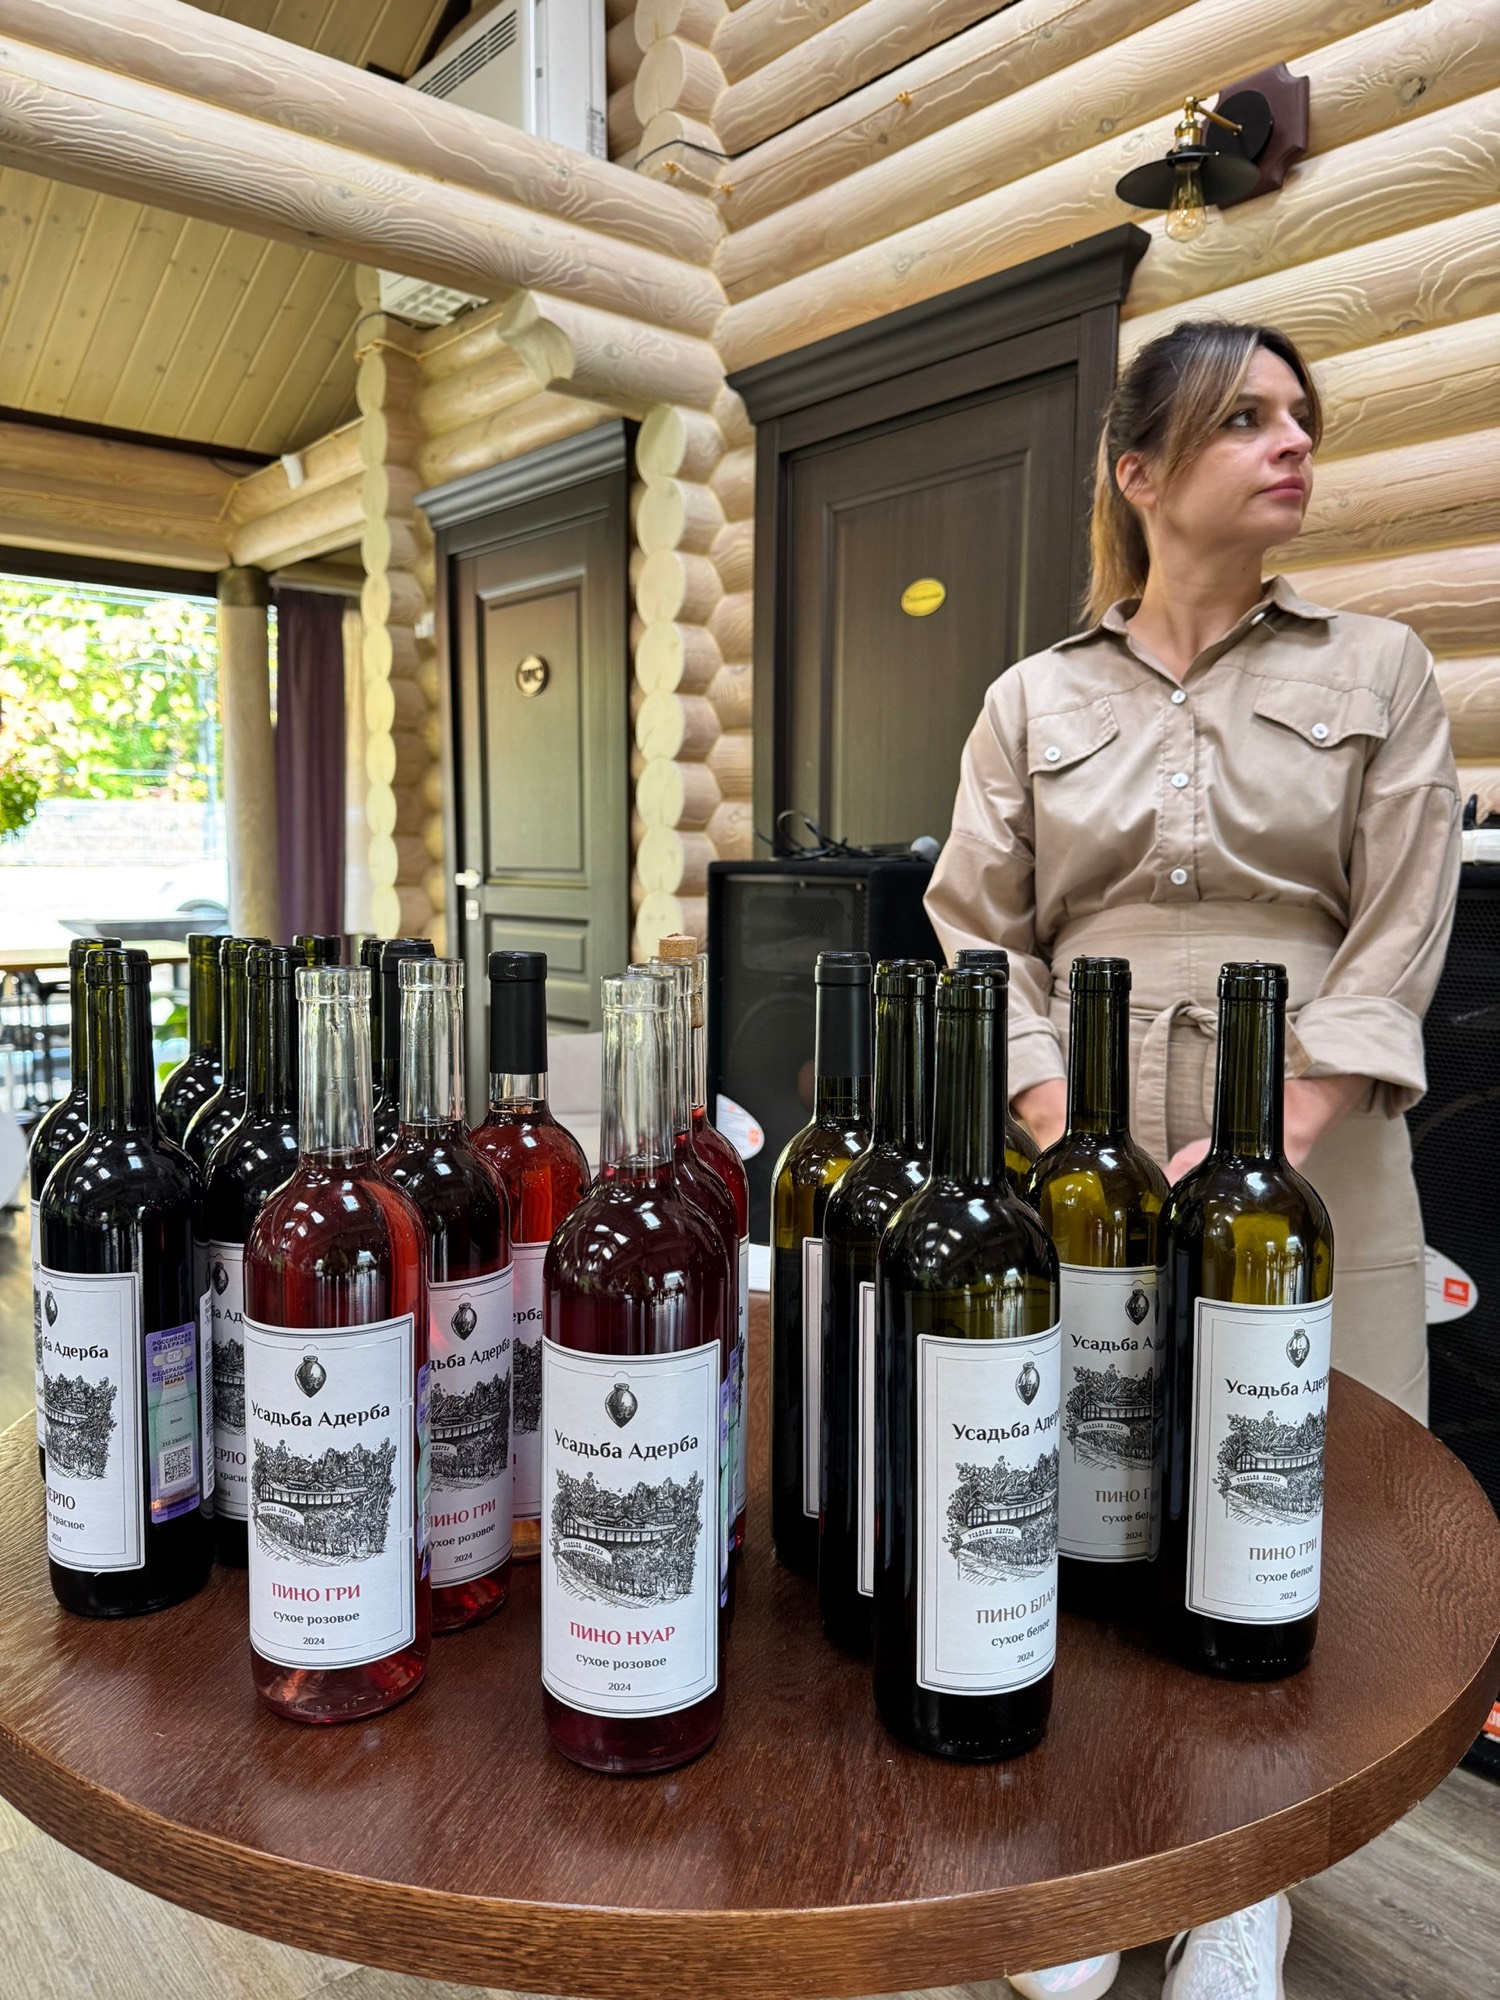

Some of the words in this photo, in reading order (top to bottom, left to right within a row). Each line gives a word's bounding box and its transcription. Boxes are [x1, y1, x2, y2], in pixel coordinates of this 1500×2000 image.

[54, 1341, 109, 1361] Адерба
[1070, 1333, 1139, 1354] Усадьба
[430, 1354, 466, 1372] дьба
[470, 1338, 511, 1364] Адерба
[164, 1376, 186, 1386] МАРКА
[1224, 1378, 1299, 1400] Усадьба
[1302, 1371, 1329, 1395] Адер
[251, 1400, 312, 1428] Усадьба
[318, 1403, 390, 1429] Адерба
[951, 1421, 1030, 1444] Усадьба
[1034, 1409, 1060, 1434] Адер
[554, 1428, 622, 1459] Усадьба
[628, 1434, 699, 1462] Адерба
[214, 1447, 246, 1466] ЕРЛО
[47, 1486, 76, 1510] ЕРЛО
[1095, 1489, 1141, 1503] ПИНО
[473, 1498, 496, 1519] ГРИ
[1101, 1514, 1133, 1525] сухое
[430, 1537, 456, 1551] ухое
[458, 1523, 496, 1546] розовое
[1125, 1531, 1143, 1540] 2024
[454, 1552, 473, 1563] 2024
[1248, 1545, 1296, 1561] ПИНО
[1255, 1572, 1288, 1585] сухое
[1290, 1564, 1314, 1579] белое
[272, 1582, 320, 1602] ПИНО
[325, 1584, 360, 1602] ГРИ
[1279, 1590, 1297, 1601] 2024
[273, 1611, 304, 1623] сухое
[307, 1612, 360, 1627] розовое
[976, 1603, 1027, 1624] ПИНО
[302, 1637, 325, 1646] 2024
[570, 1621, 621, 1646] ПИНО
[627, 1626, 676, 1646] НУАР
[991, 1632, 1025, 1649] сухое
[576, 1653, 610, 1667] сухое
[613, 1657, 667, 1672] розовое
[1016, 1650, 1034, 1663] 2024
[608, 1682, 631, 1692] 2024
